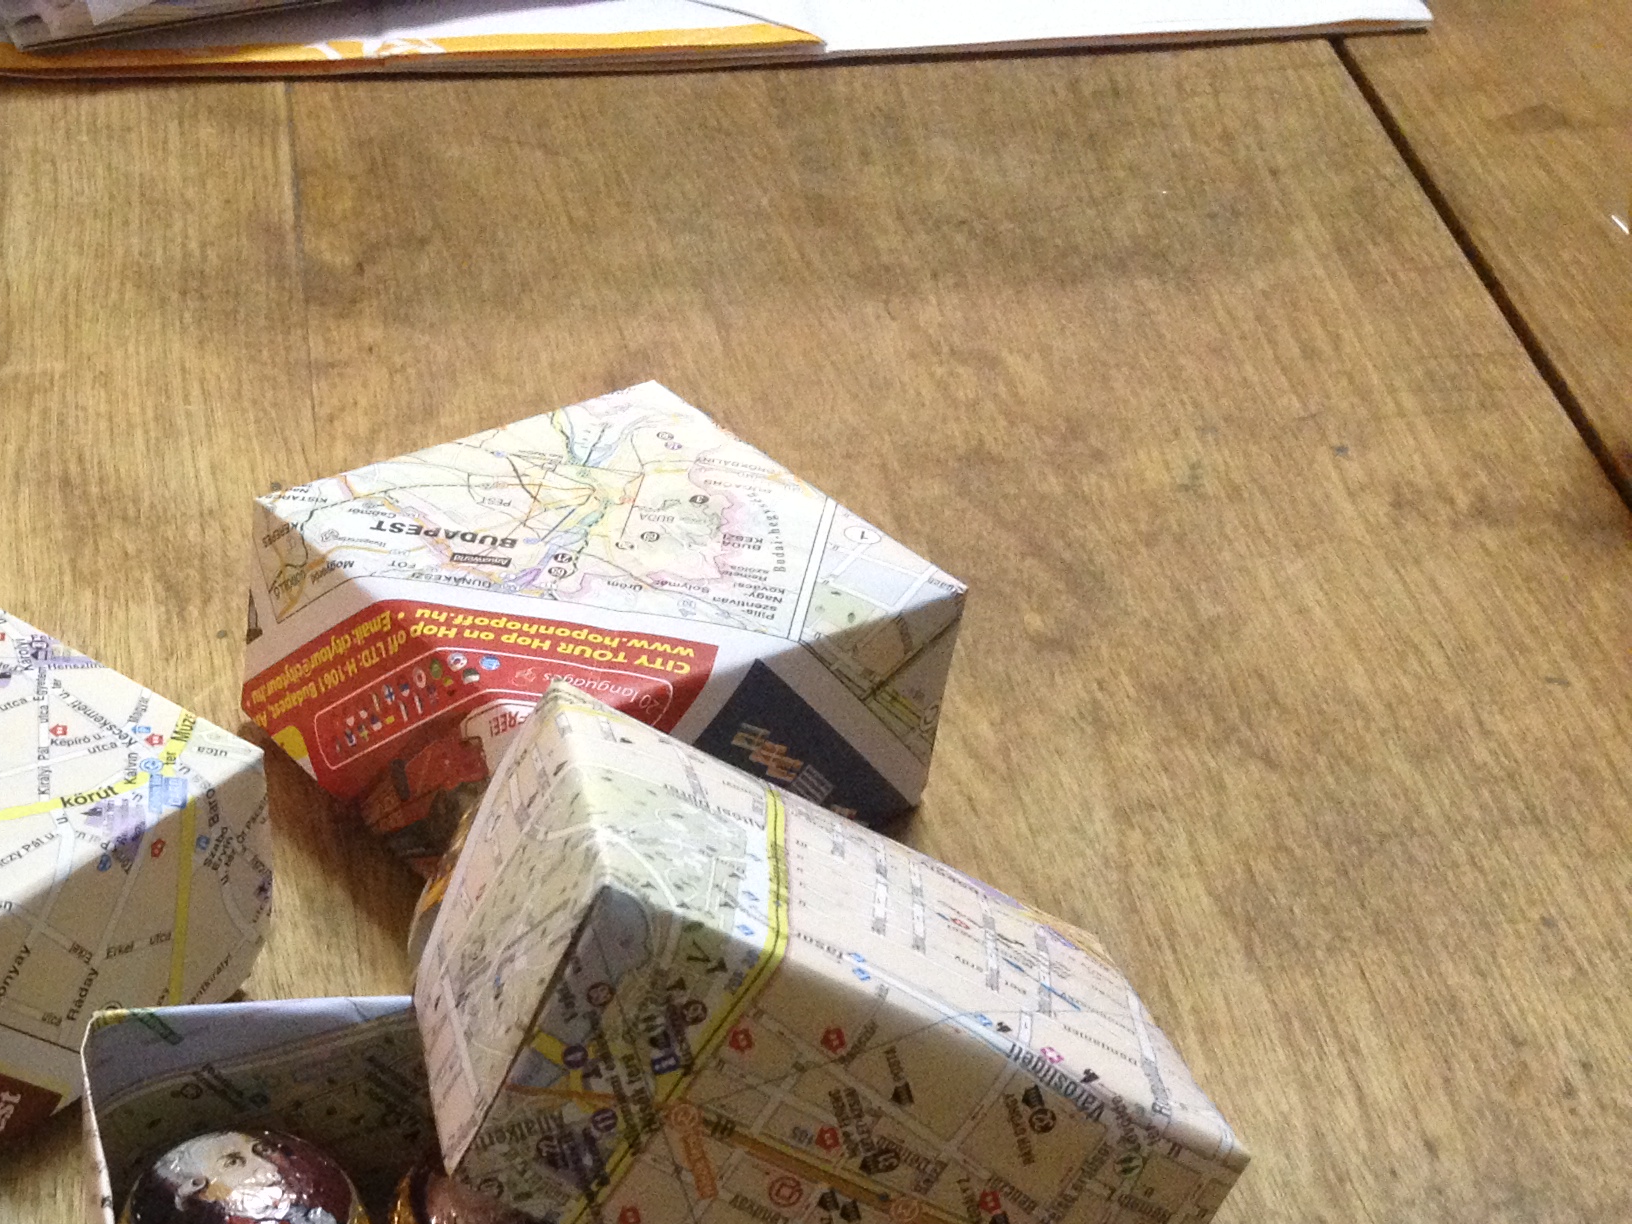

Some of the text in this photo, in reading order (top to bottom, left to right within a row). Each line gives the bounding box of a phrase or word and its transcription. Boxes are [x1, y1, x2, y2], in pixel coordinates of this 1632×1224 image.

[369, 520, 518, 549] BUDAPEST
[357, 611, 392, 641] Email:
[410, 624, 457, 641] Hop
[416, 608, 695, 659] www.hoponhopoff.hu
[464, 628, 494, 643] on
[388, 630, 408, 655] off
[501, 628, 552, 652] Hop
[556, 640, 629, 664] TOUR
[635, 652, 691, 675] CITY
[0, 696, 28, 712] utca
[87, 741, 119, 756] utca
[61, 784, 120, 809] körút
[20, 836, 44, 854] Pál
[66, 967, 100, 1021] Ráday
